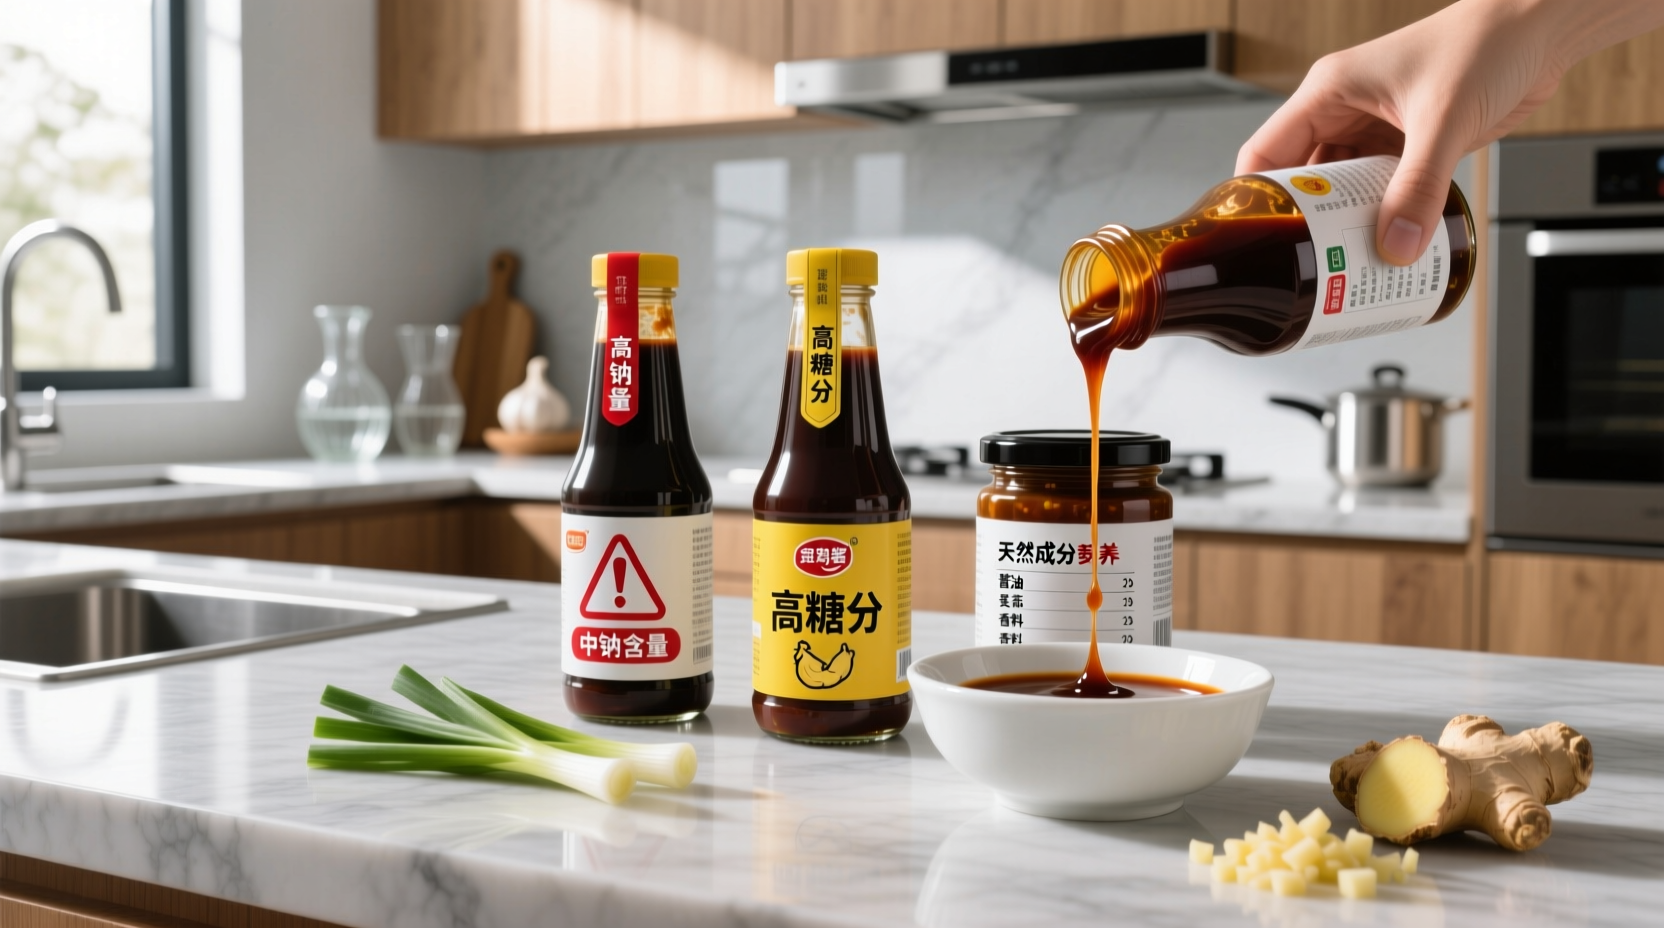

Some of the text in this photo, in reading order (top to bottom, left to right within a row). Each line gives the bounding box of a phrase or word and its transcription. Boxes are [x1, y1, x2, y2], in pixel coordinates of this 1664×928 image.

[810, 324, 834, 403] 高糖分
[771, 589, 883, 635] 高糖分
